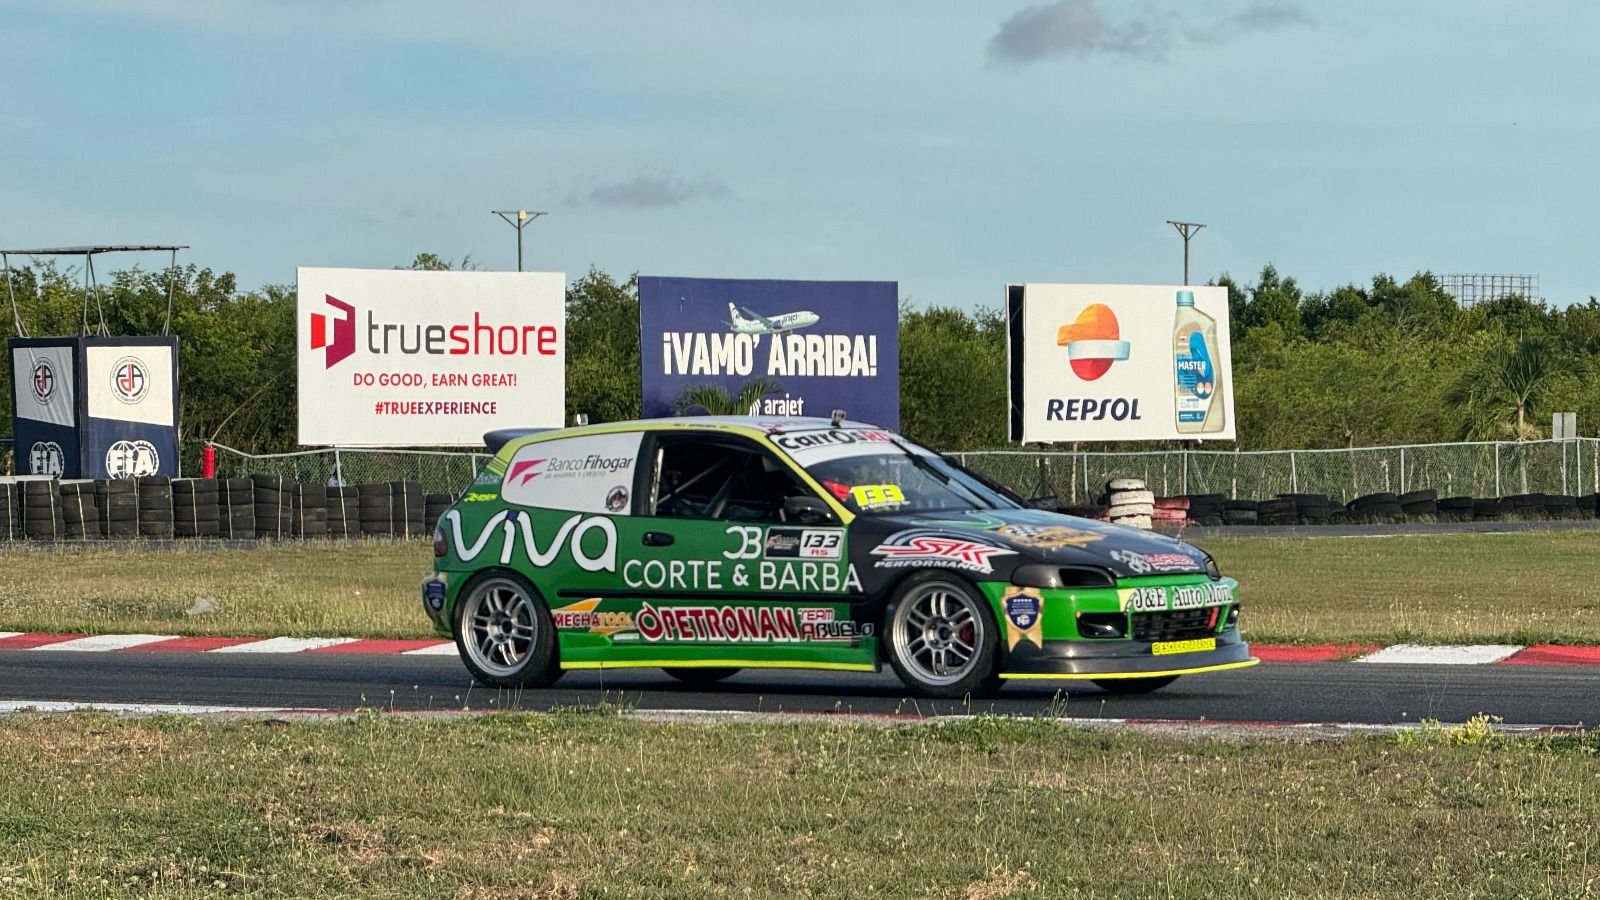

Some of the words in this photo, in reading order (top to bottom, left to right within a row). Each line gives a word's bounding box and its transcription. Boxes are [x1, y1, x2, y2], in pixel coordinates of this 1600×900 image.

[367, 309, 557, 355] trueshore
[663, 332, 760, 376] ¡VAMO'
[768, 333, 877, 377] ARRIBA!
[1178, 361, 1206, 371] MASTER
[353, 373, 375, 387] DO
[378, 373, 428, 389] GOOD,
[432, 373, 468, 387] EARN
[472, 373, 518, 387] GREAT!
[375, 401, 497, 415] #TRUEEXPERIENCE
[764, 393, 804, 417] arajet
[1046, 398, 1142, 421] REPSOL
[547, 458, 583, 472] Banco
[583, 454, 633, 473] Fihogar
[446, 509, 618, 573] viva
[803, 534, 840, 548] 133
[623, 559, 722, 589] CORTE
[732, 563, 749, 587] &
[760, 560, 864, 592] BARBA
[873, 559, 995, 575] PERFORMANCE
[1135, 588, 1167, 608] J&E
[1174, 587, 1203, 606] Auto
[798, 609, 834, 621] TEAM
[800, 621, 875, 640] ABUELO
